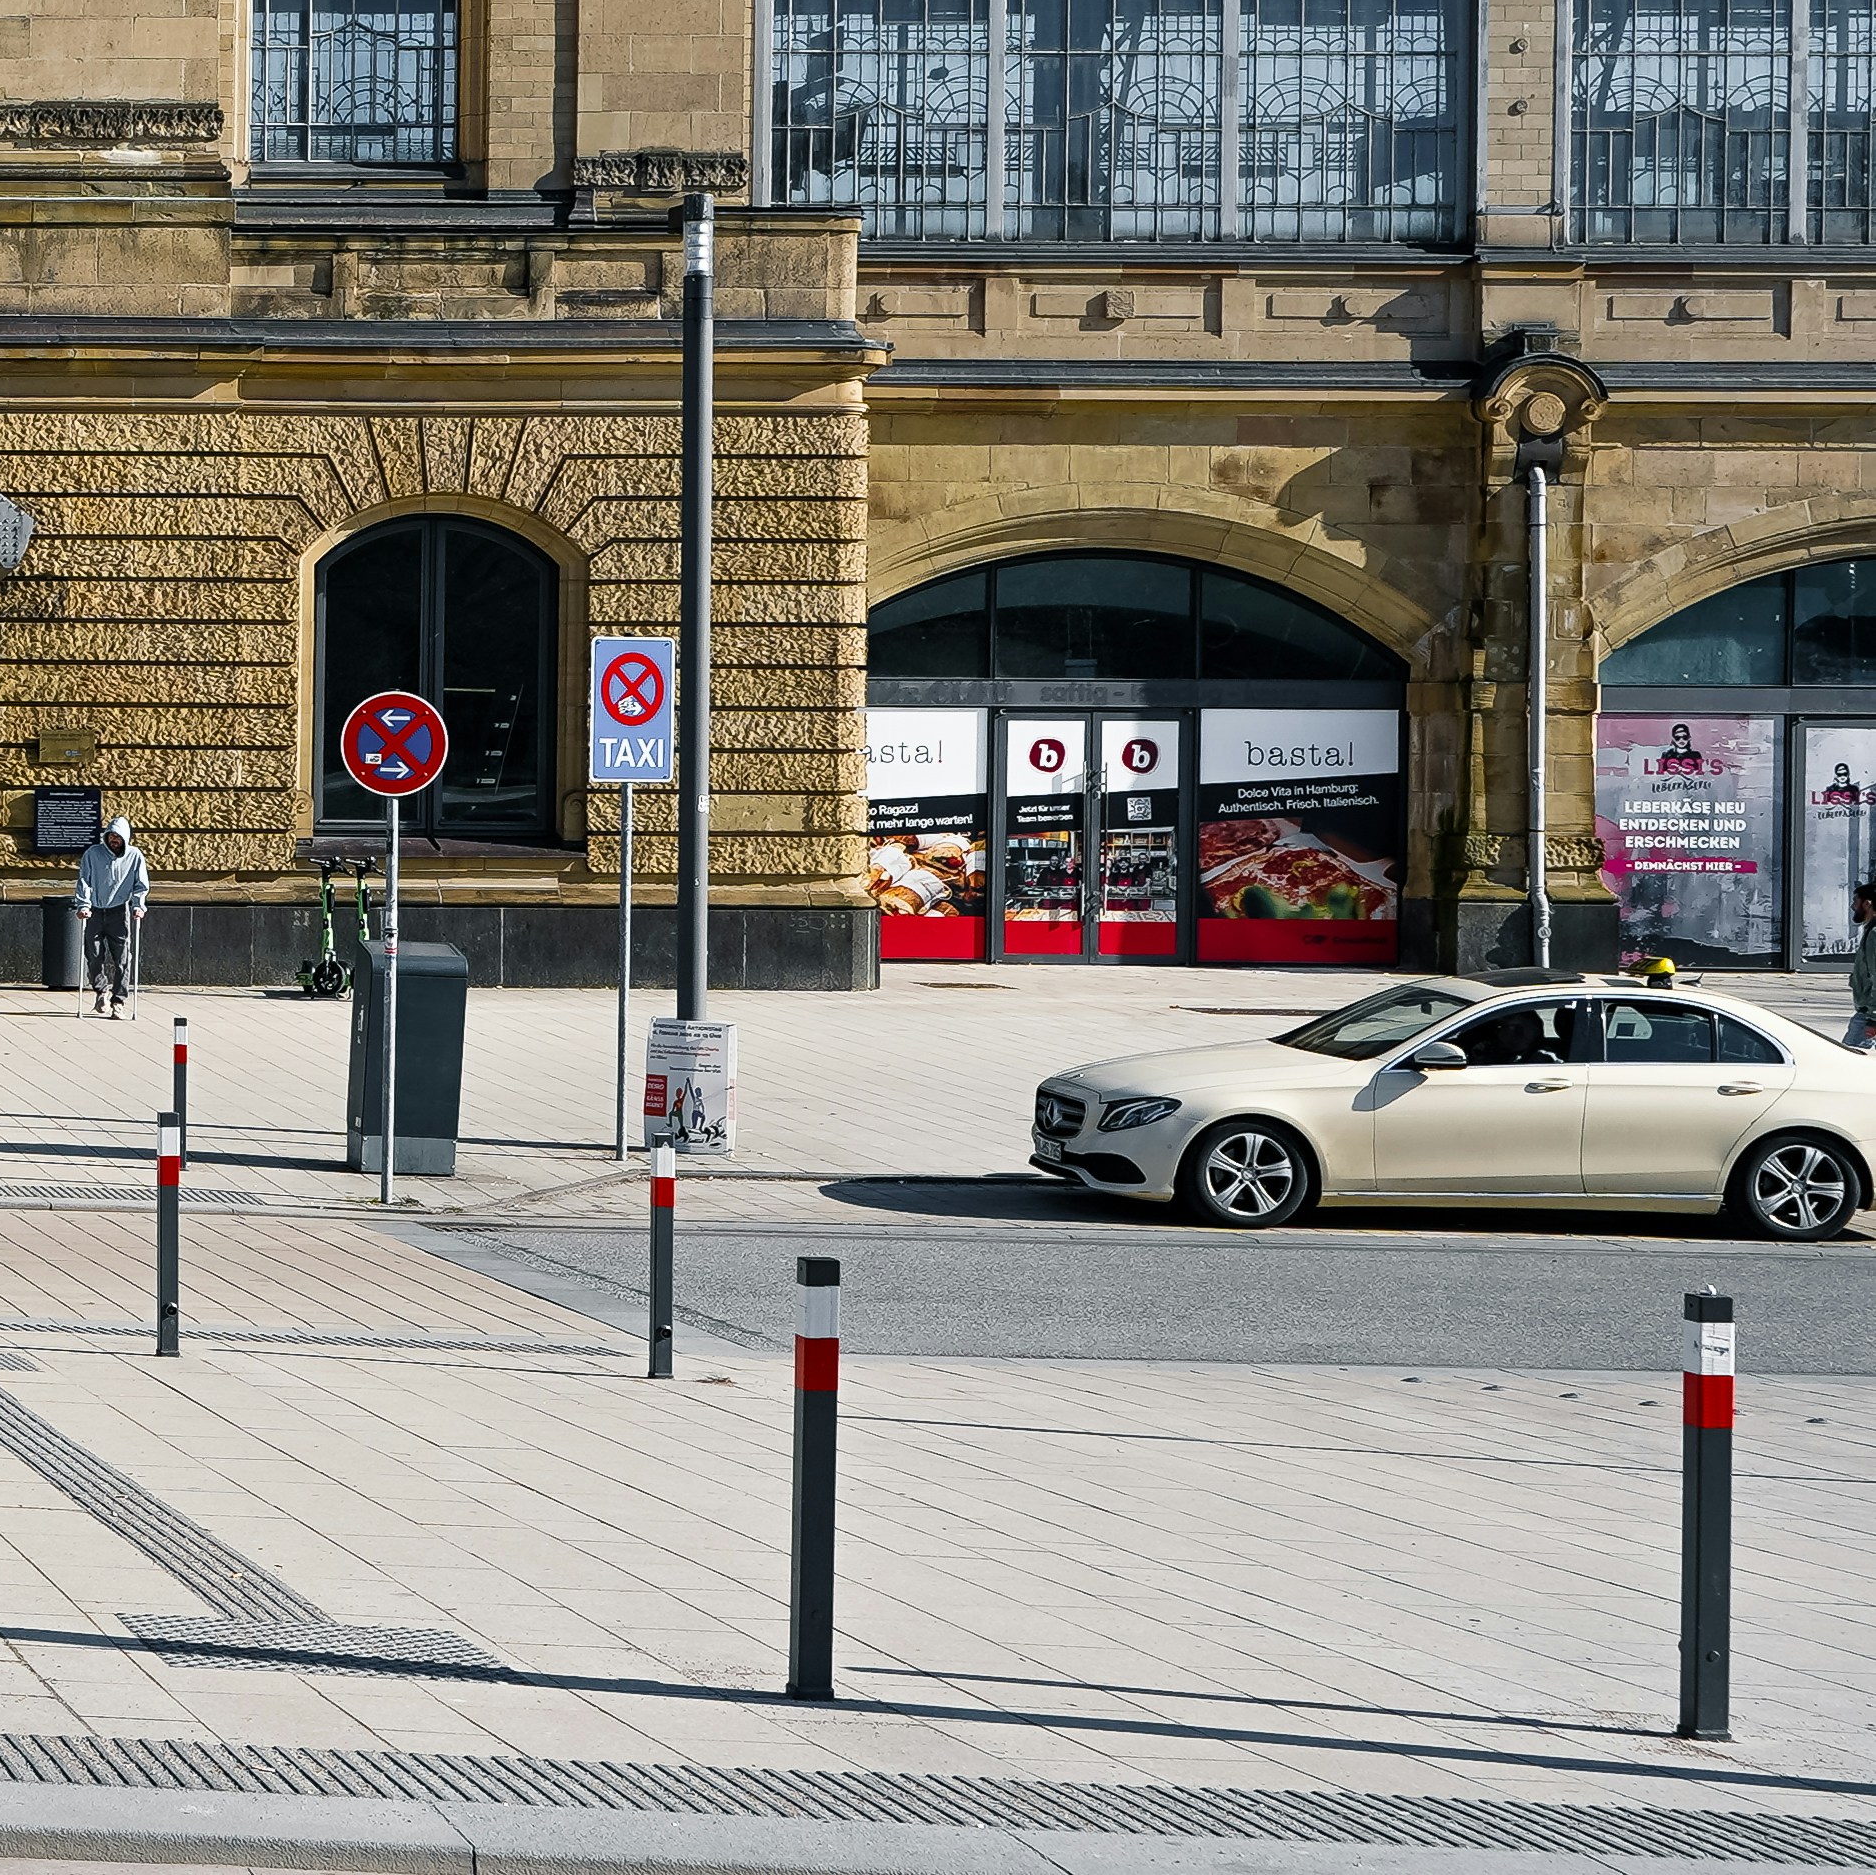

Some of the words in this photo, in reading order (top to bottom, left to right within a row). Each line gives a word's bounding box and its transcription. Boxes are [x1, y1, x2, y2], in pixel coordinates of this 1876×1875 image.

[599, 737, 665, 768] TAXI
[864, 740, 944, 764] asta!
[1244, 740, 1354, 767] basta!
[1644, 758, 1724, 775] LISSI'S
[1238, 788, 1268, 799] Dolce
[1271, 786, 1292, 796] Vita
[1294, 785, 1304, 795] in
[1306, 783, 1358, 795] Hamburg:
[878, 803, 919, 816] Ragazzi
[1038, 804, 1050, 812] für
[1218, 801, 1284, 814] Authentisch.
[1286, 798, 1321, 810] Frisch.
[1323, 796, 1380, 807] Italienisch.
[1624, 798, 1712, 815] LEBERKÄSE
[1714, 801, 1746, 815] NEU
[876, 819, 903, 829] mehr
[905, 816, 933, 830] lange
[935, 814, 974, 826] warten!
[1619, 818, 1712, 832] ENTDECKEN
[1714, 818, 1747, 832] UND
[1625, 836, 1740, 849] ERSCHMECKEN
[1634, 859, 1704, 872] DEMNÄCHST
[1705, 861, 1733, 872] HIER
